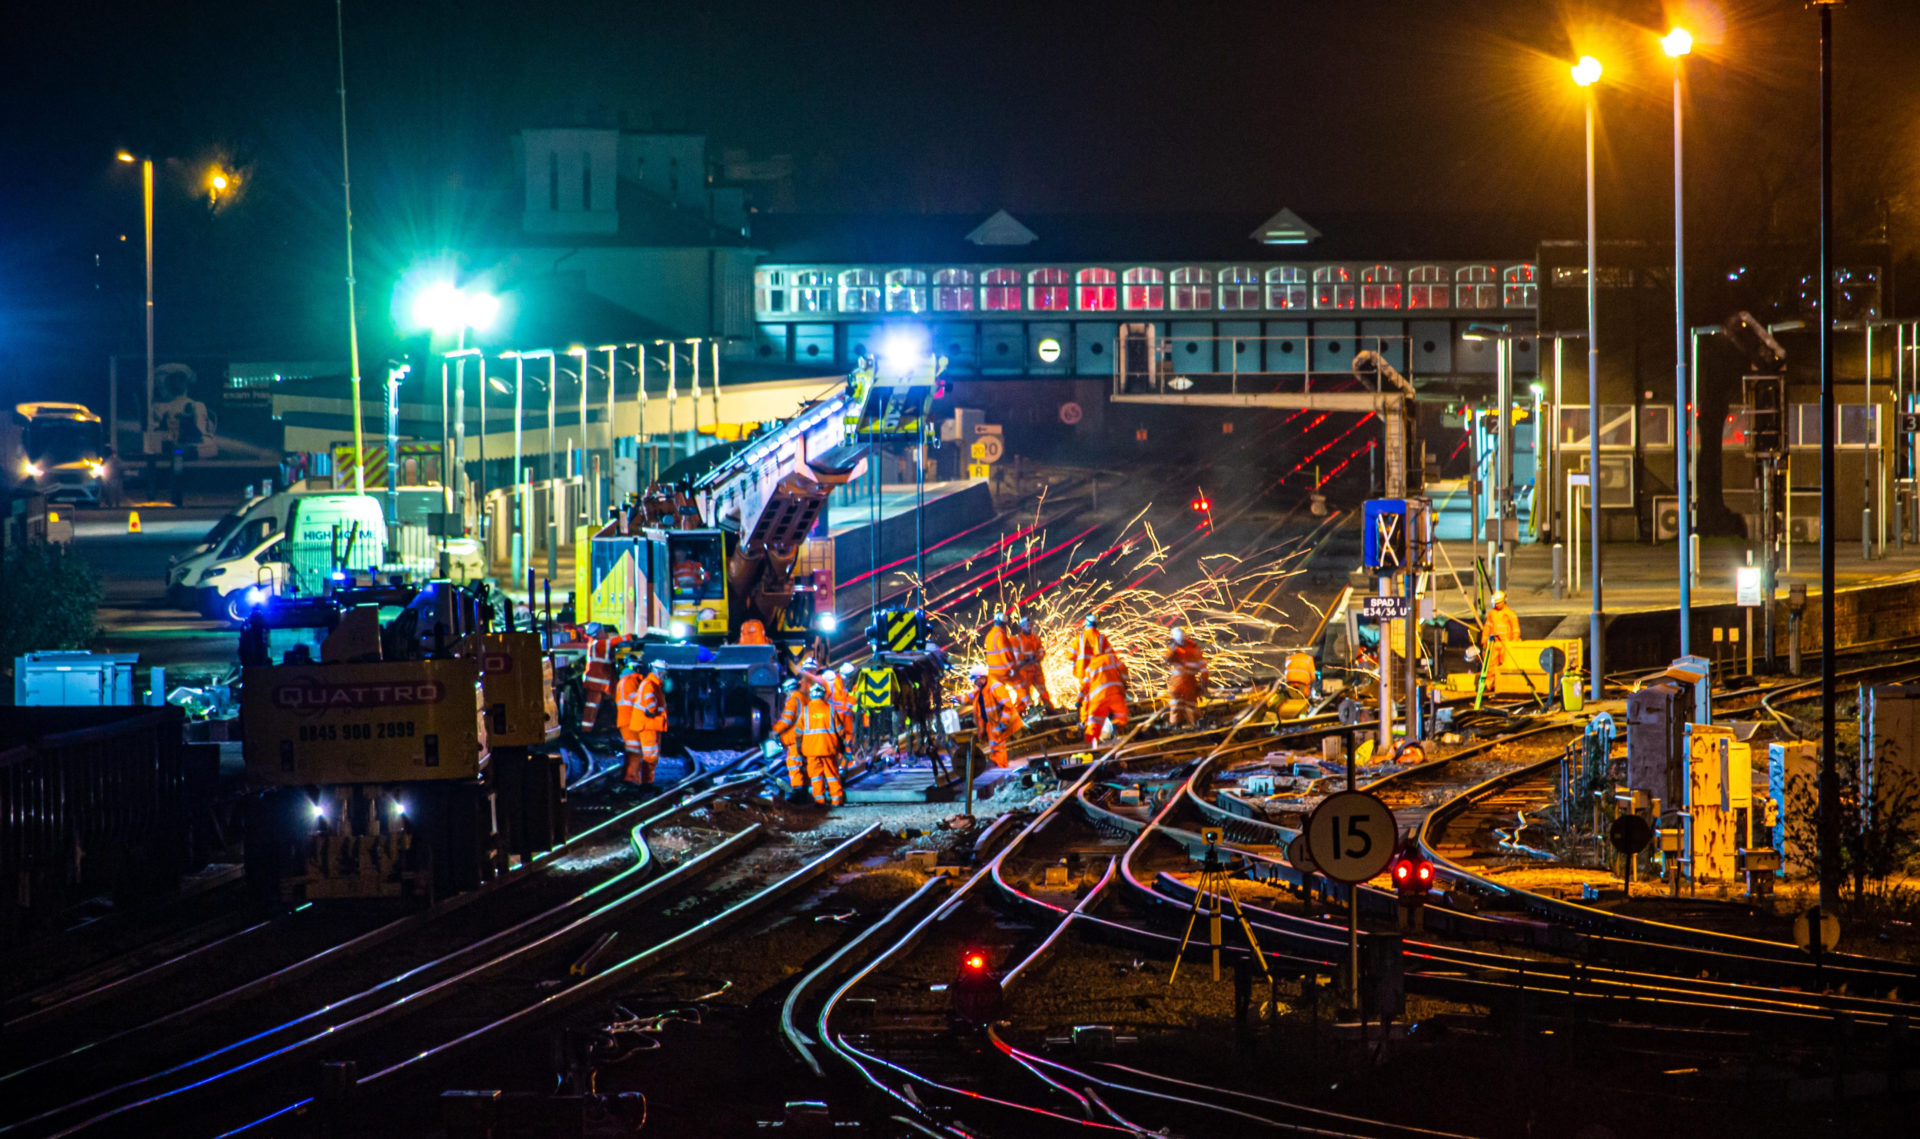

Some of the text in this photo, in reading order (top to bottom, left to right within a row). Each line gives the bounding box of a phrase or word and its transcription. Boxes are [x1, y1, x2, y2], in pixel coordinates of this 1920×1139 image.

[1907, 415, 1917, 430] 3
[303, 530, 332, 540] HIGH
[1370, 598, 1394, 607] SPAD
[1363, 607, 1397, 617] E34/36
[279, 684, 438, 707] QUATTRO
[300, 723, 337, 741] 0845
[342, 722, 372, 740] 900
[1332, 814, 1372, 860] 15
